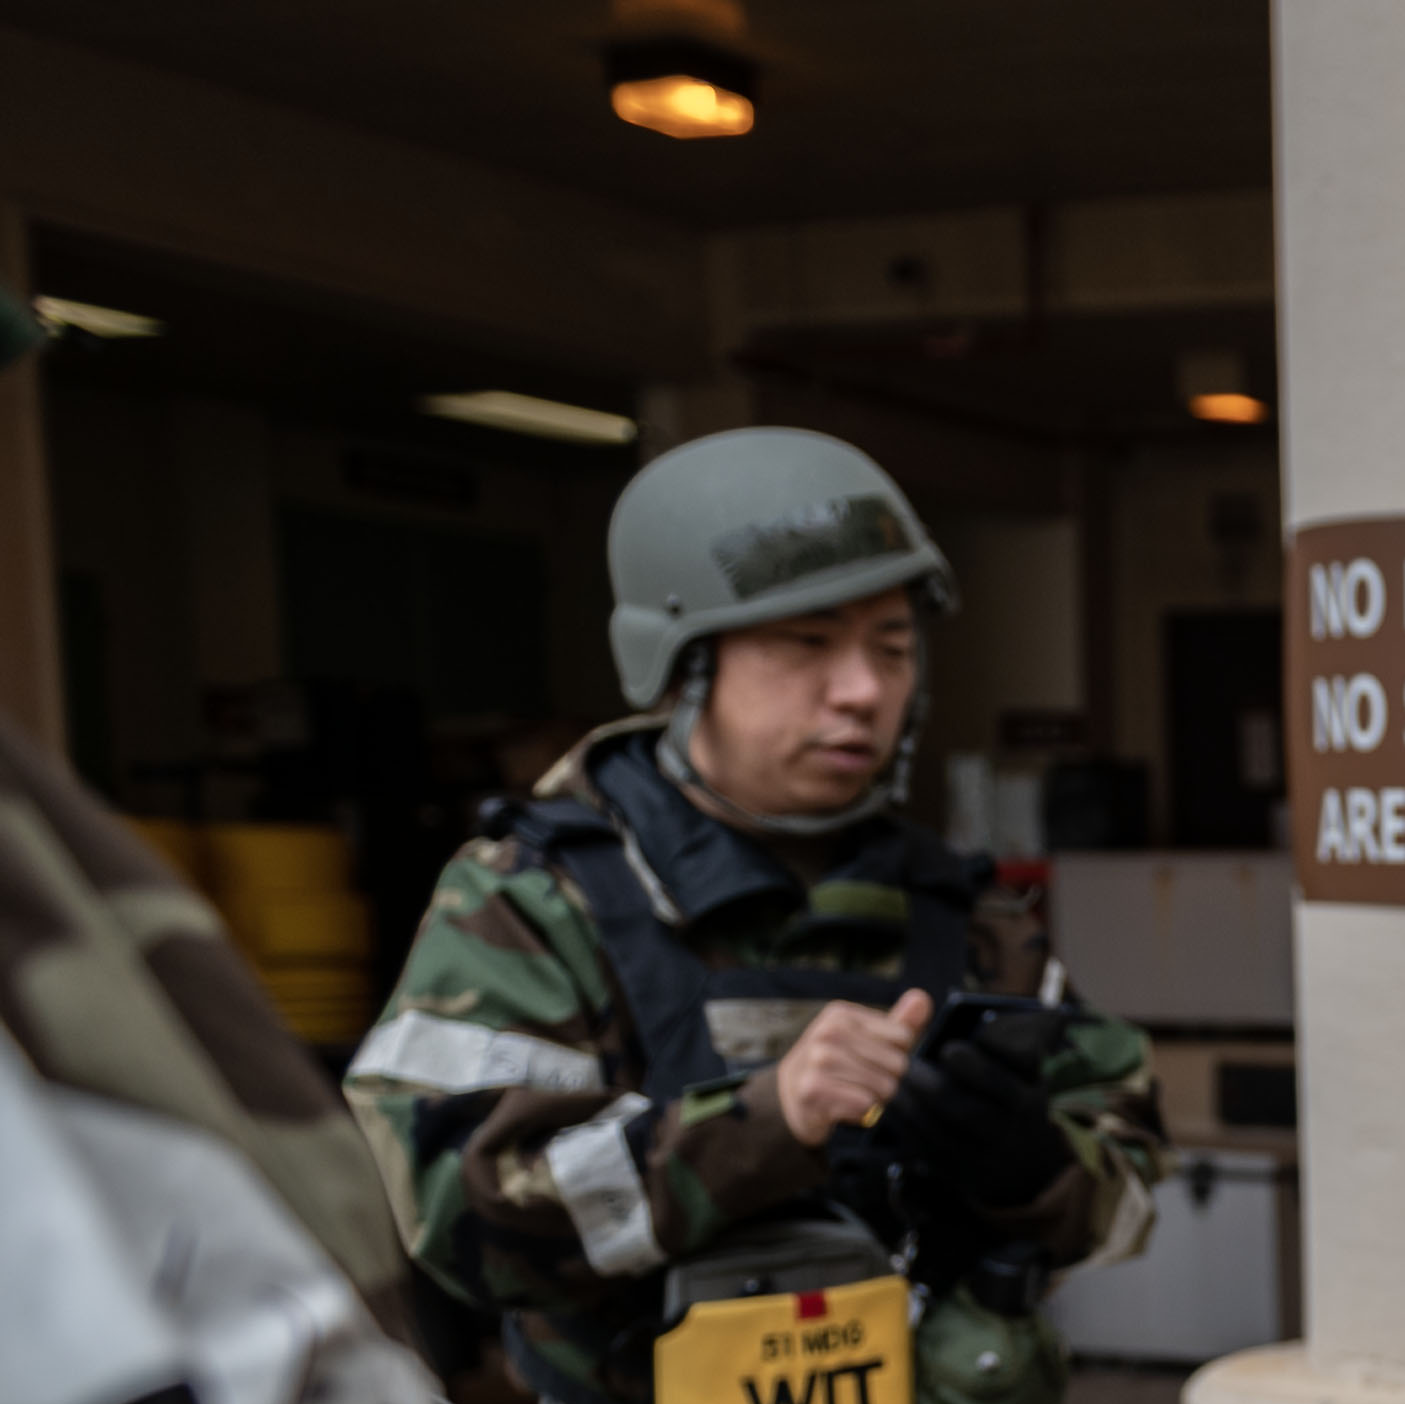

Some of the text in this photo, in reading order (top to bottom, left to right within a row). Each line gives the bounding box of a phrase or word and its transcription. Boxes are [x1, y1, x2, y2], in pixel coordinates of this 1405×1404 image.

[1310, 558, 1386, 639] NO
[1313, 673, 1388, 753] NO
[762, 1333, 794, 1360] 51
